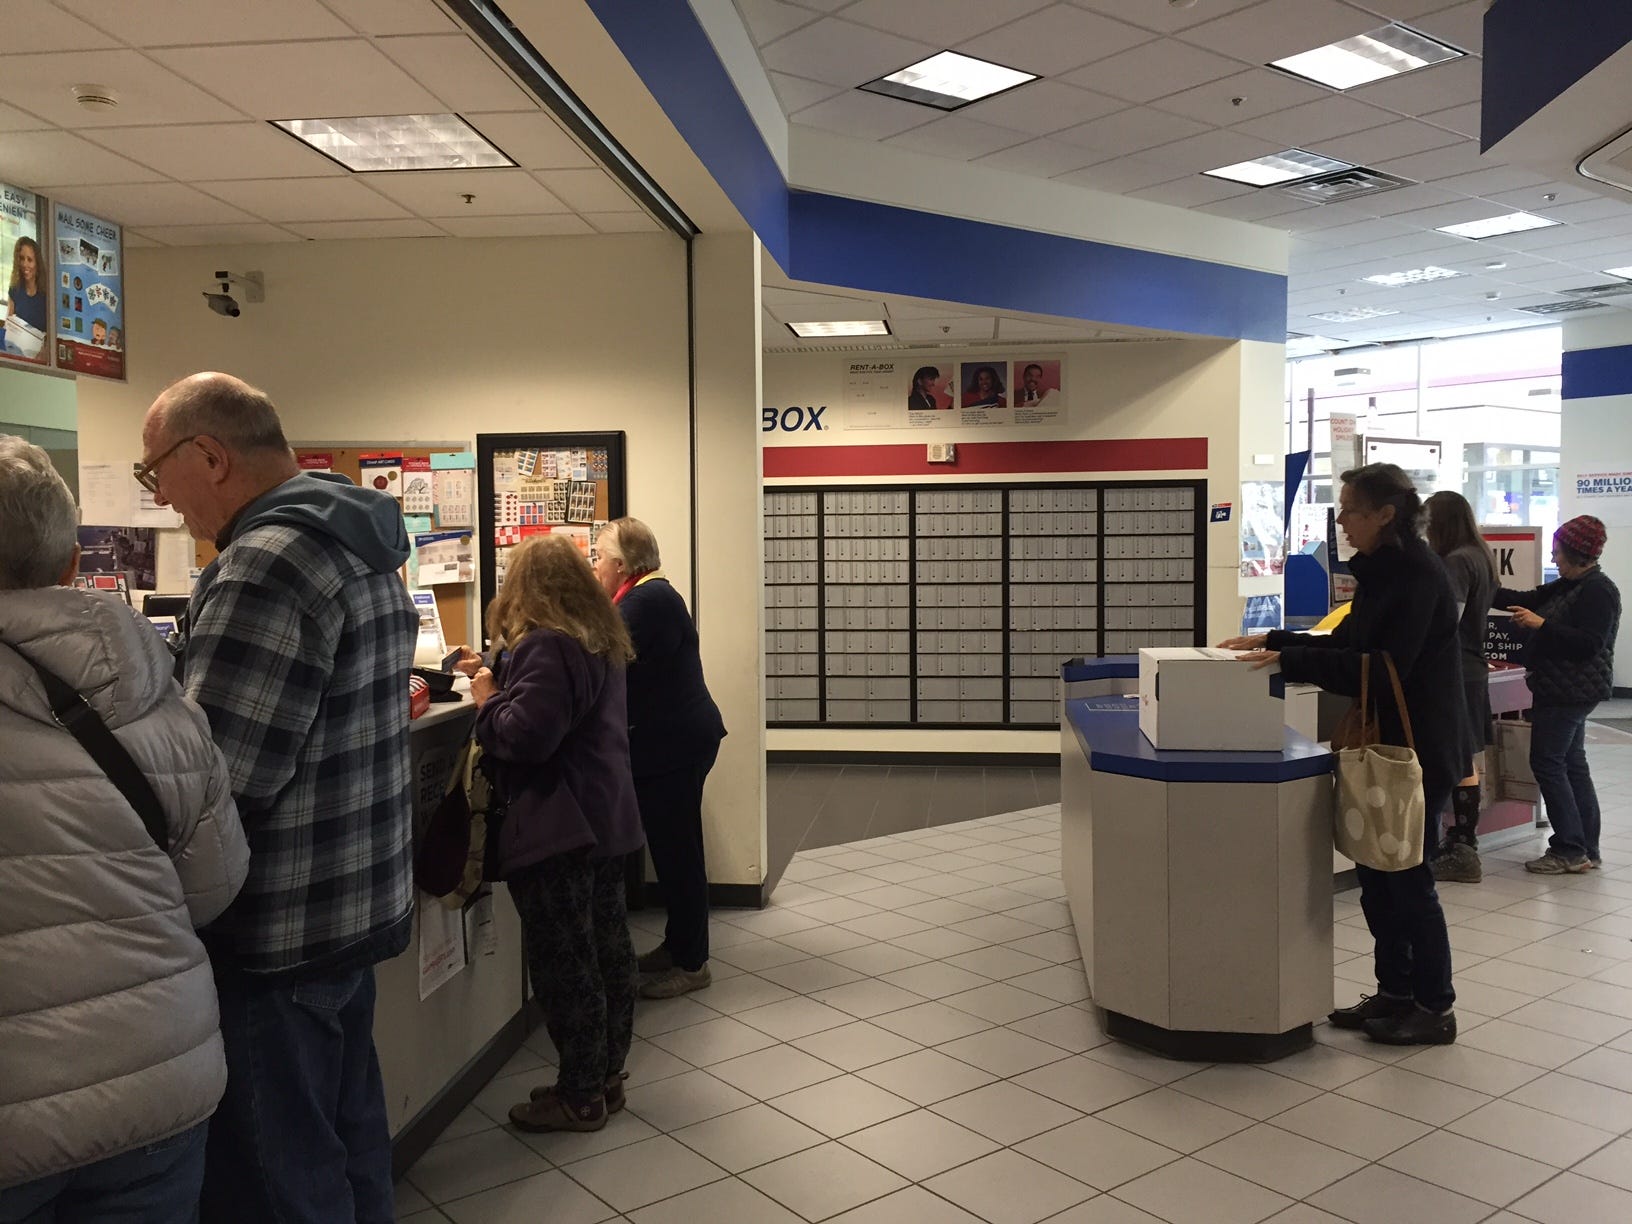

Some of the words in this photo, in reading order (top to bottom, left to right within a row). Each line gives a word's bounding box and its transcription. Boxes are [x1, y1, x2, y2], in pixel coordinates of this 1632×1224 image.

[58, 212, 74, 227] MAIL
[75, 217, 94, 233] SOME
[96, 225, 117, 240] CHEER
[762, 406, 827, 432] BOX
[1577, 479, 1590, 487] 90
[1489, 633, 1510, 641] PAY,
[1498, 642, 1523, 650] SHIP
